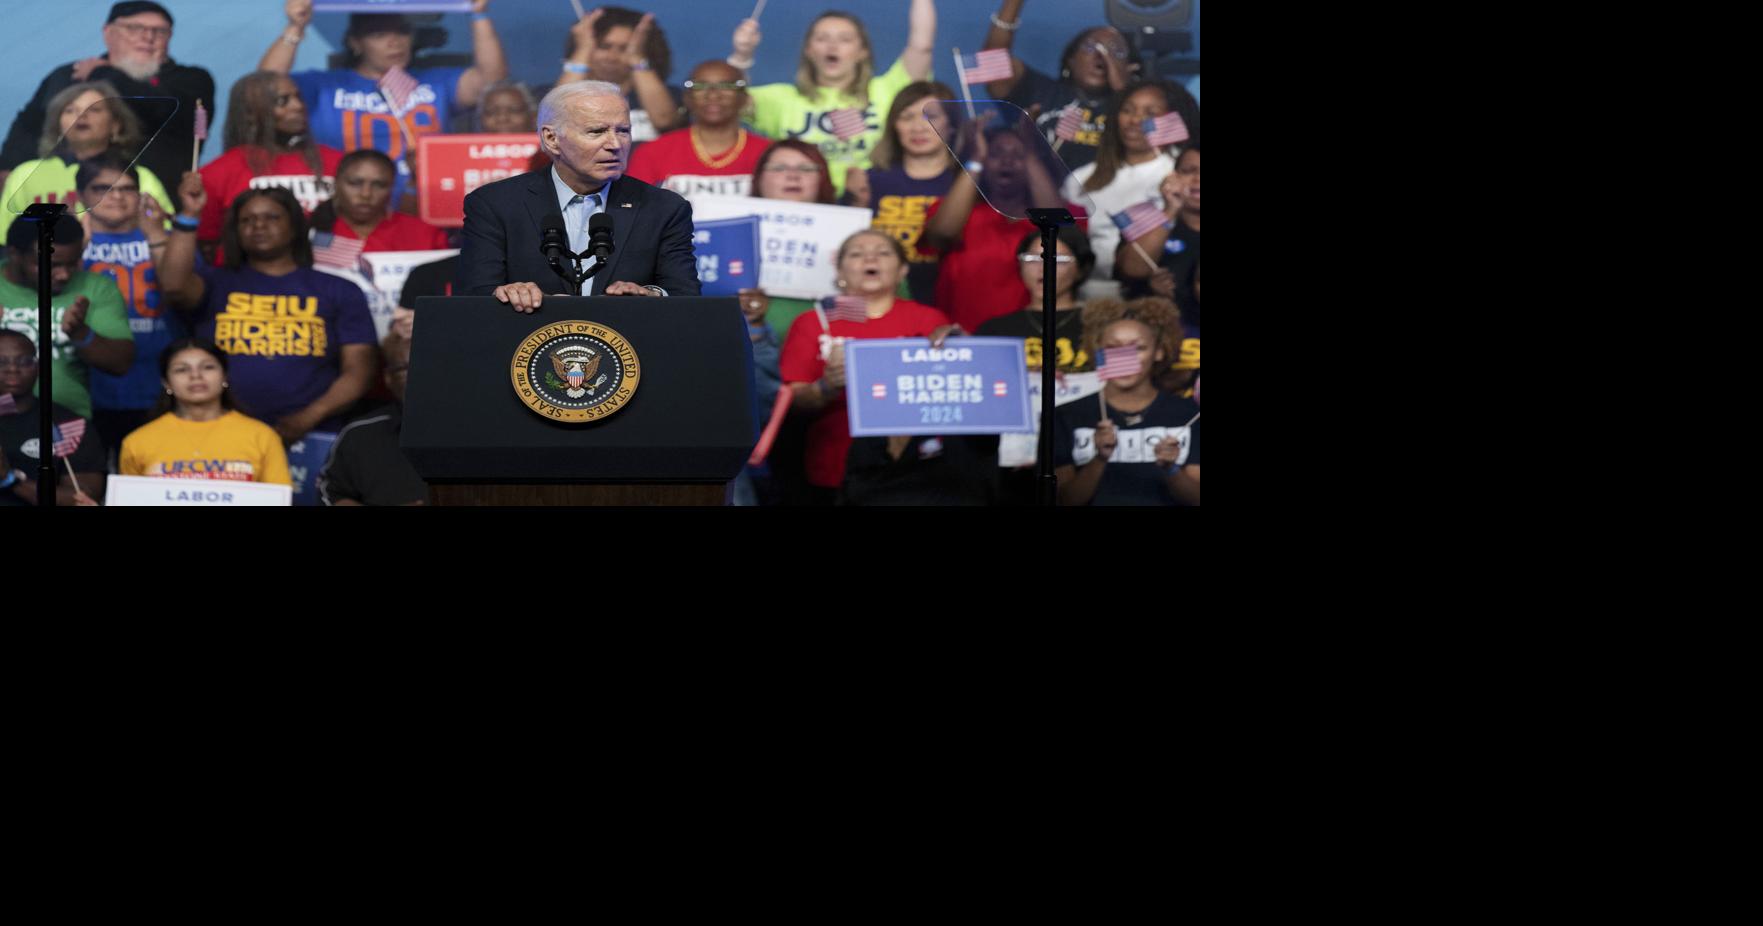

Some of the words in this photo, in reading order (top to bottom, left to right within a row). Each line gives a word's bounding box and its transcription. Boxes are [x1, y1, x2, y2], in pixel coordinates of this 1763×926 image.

[766, 238, 818, 256] DEN
[226, 292, 319, 318] SEIU
[215, 319, 311, 340] BIDEN
[591, 327, 608, 338] THE
[515, 324, 574, 369] PRESIDENT
[609, 337, 636, 378] UNITED
[901, 348, 973, 363] LABOR
[517, 372, 526, 386] THE
[896, 374, 983, 391] BIDEN
[522, 388, 532, 397] OF
[898, 390, 984, 404] HARRIS
[531, 396, 563, 418] SEAL
[586, 387, 630, 418] STATES
[920, 406, 963, 424] 2024
[161, 460, 226, 474] UFCW
[165, 491, 234, 503] LABOR
